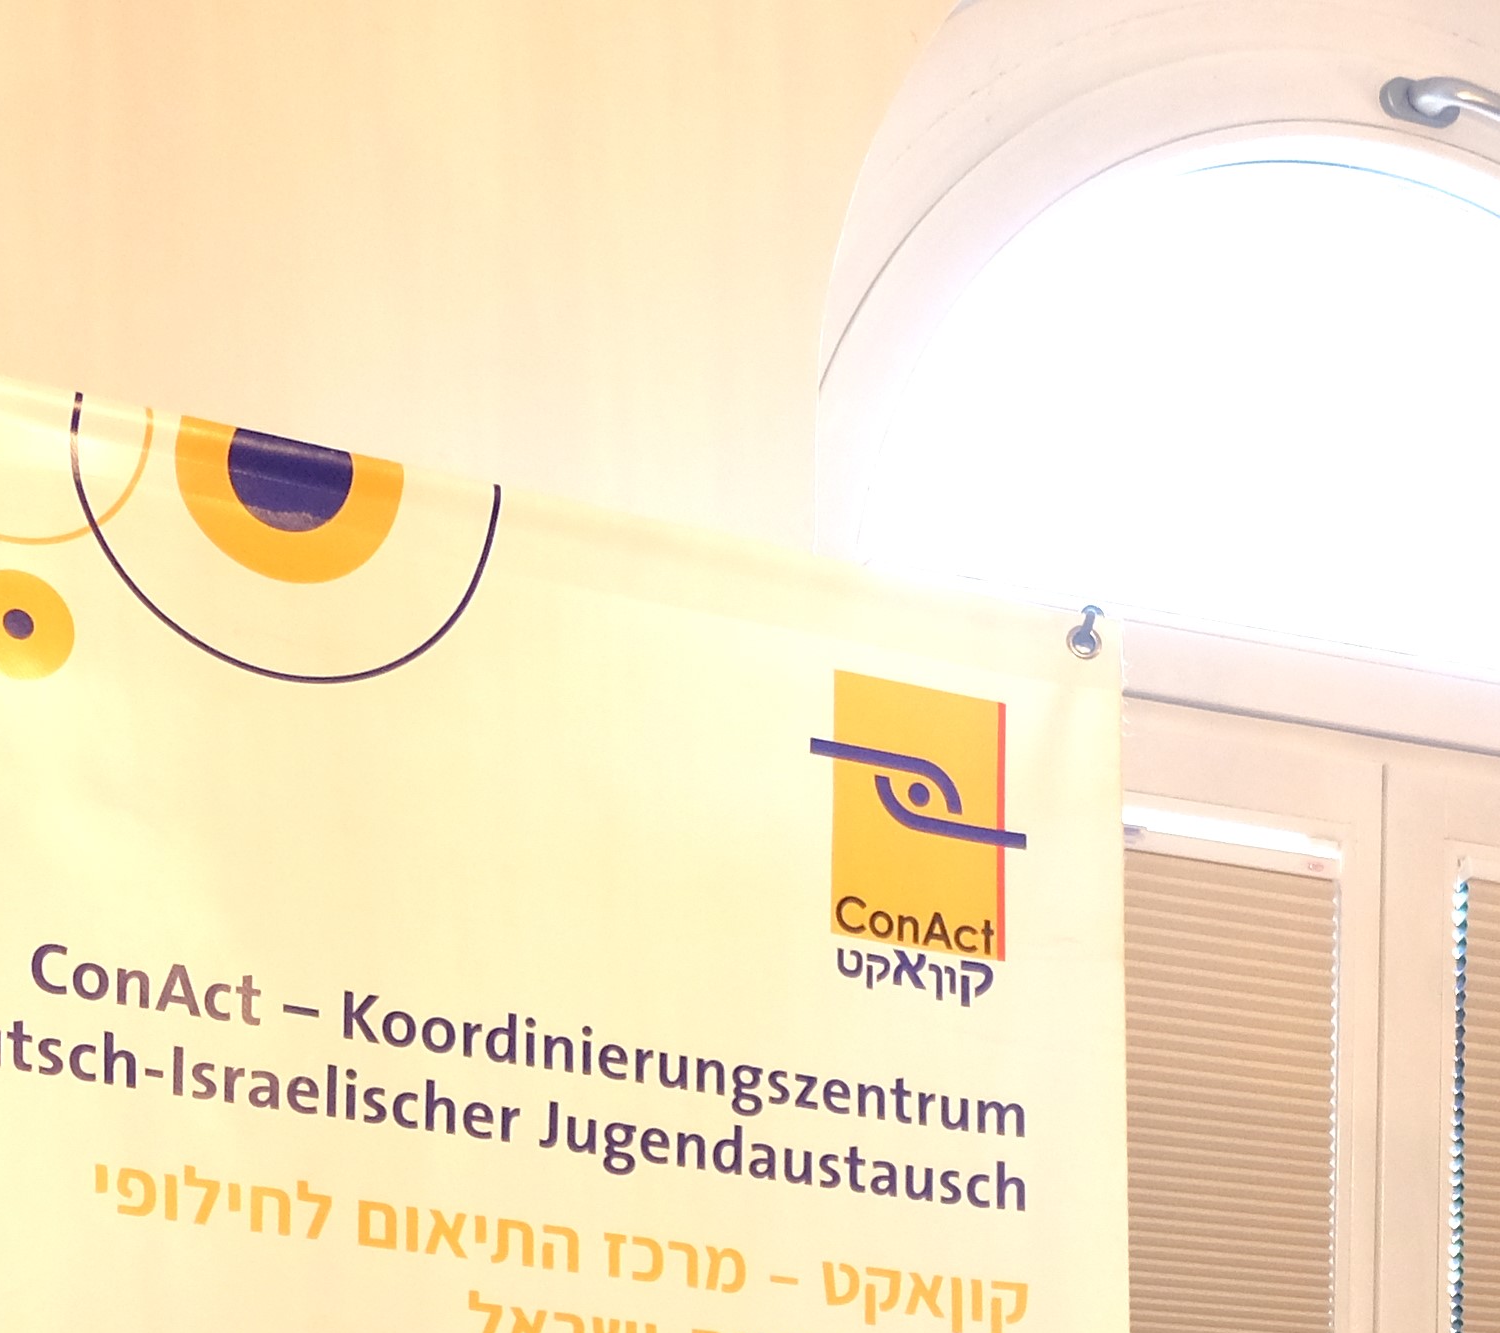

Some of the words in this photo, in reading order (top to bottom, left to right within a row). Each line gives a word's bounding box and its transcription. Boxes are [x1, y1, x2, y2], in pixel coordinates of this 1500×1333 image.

[835, 895, 995, 956] ConAct
[30, 941, 262, 1028] ConAct
[342, 989, 1028, 1138] Koordinierungszentrum
[538, 1099, 1028, 1212] Jugendaustausch
[92, 1160, 334, 1241] לחילופי
[356, 1200, 581, 1275] התיאום
[605, 1232, 748, 1294] מרכז
